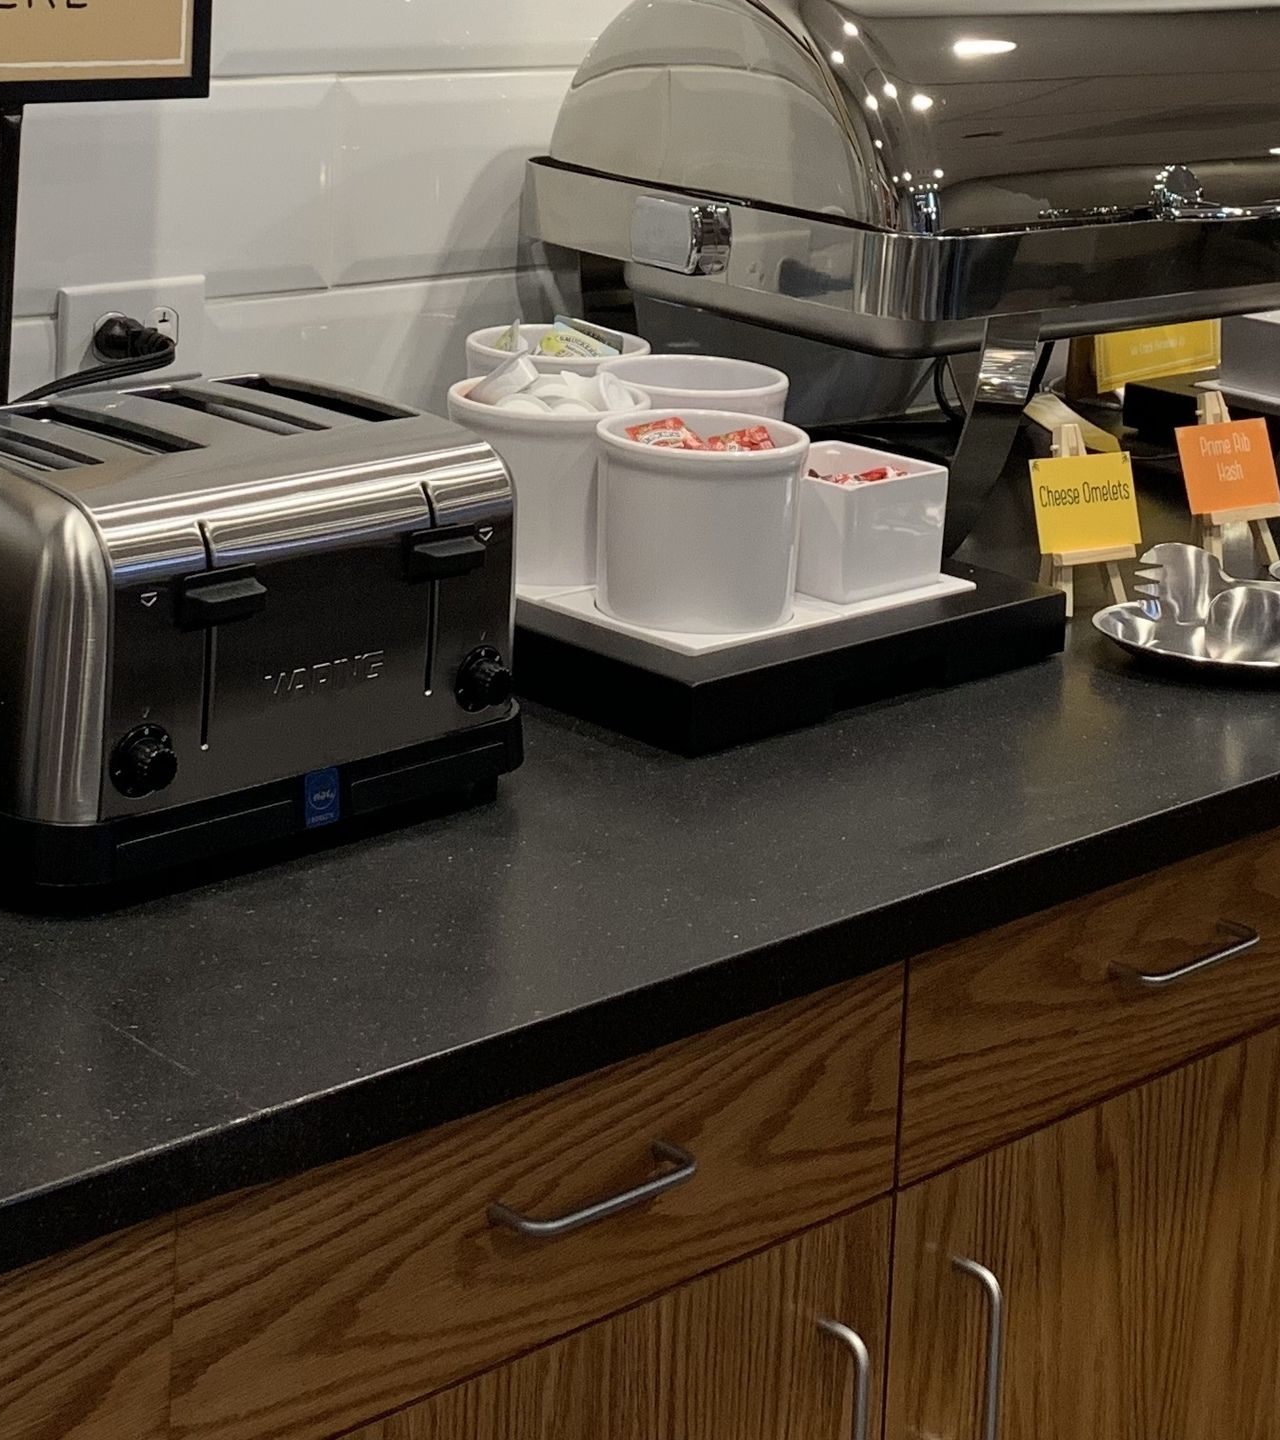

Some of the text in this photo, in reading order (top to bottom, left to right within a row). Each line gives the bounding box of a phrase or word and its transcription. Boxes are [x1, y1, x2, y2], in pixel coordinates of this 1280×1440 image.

[1199, 431, 1251, 458] Prime Rib
[1216, 459, 1245, 482] Hash
[1039, 479, 1131, 508] Cheese Omelets
